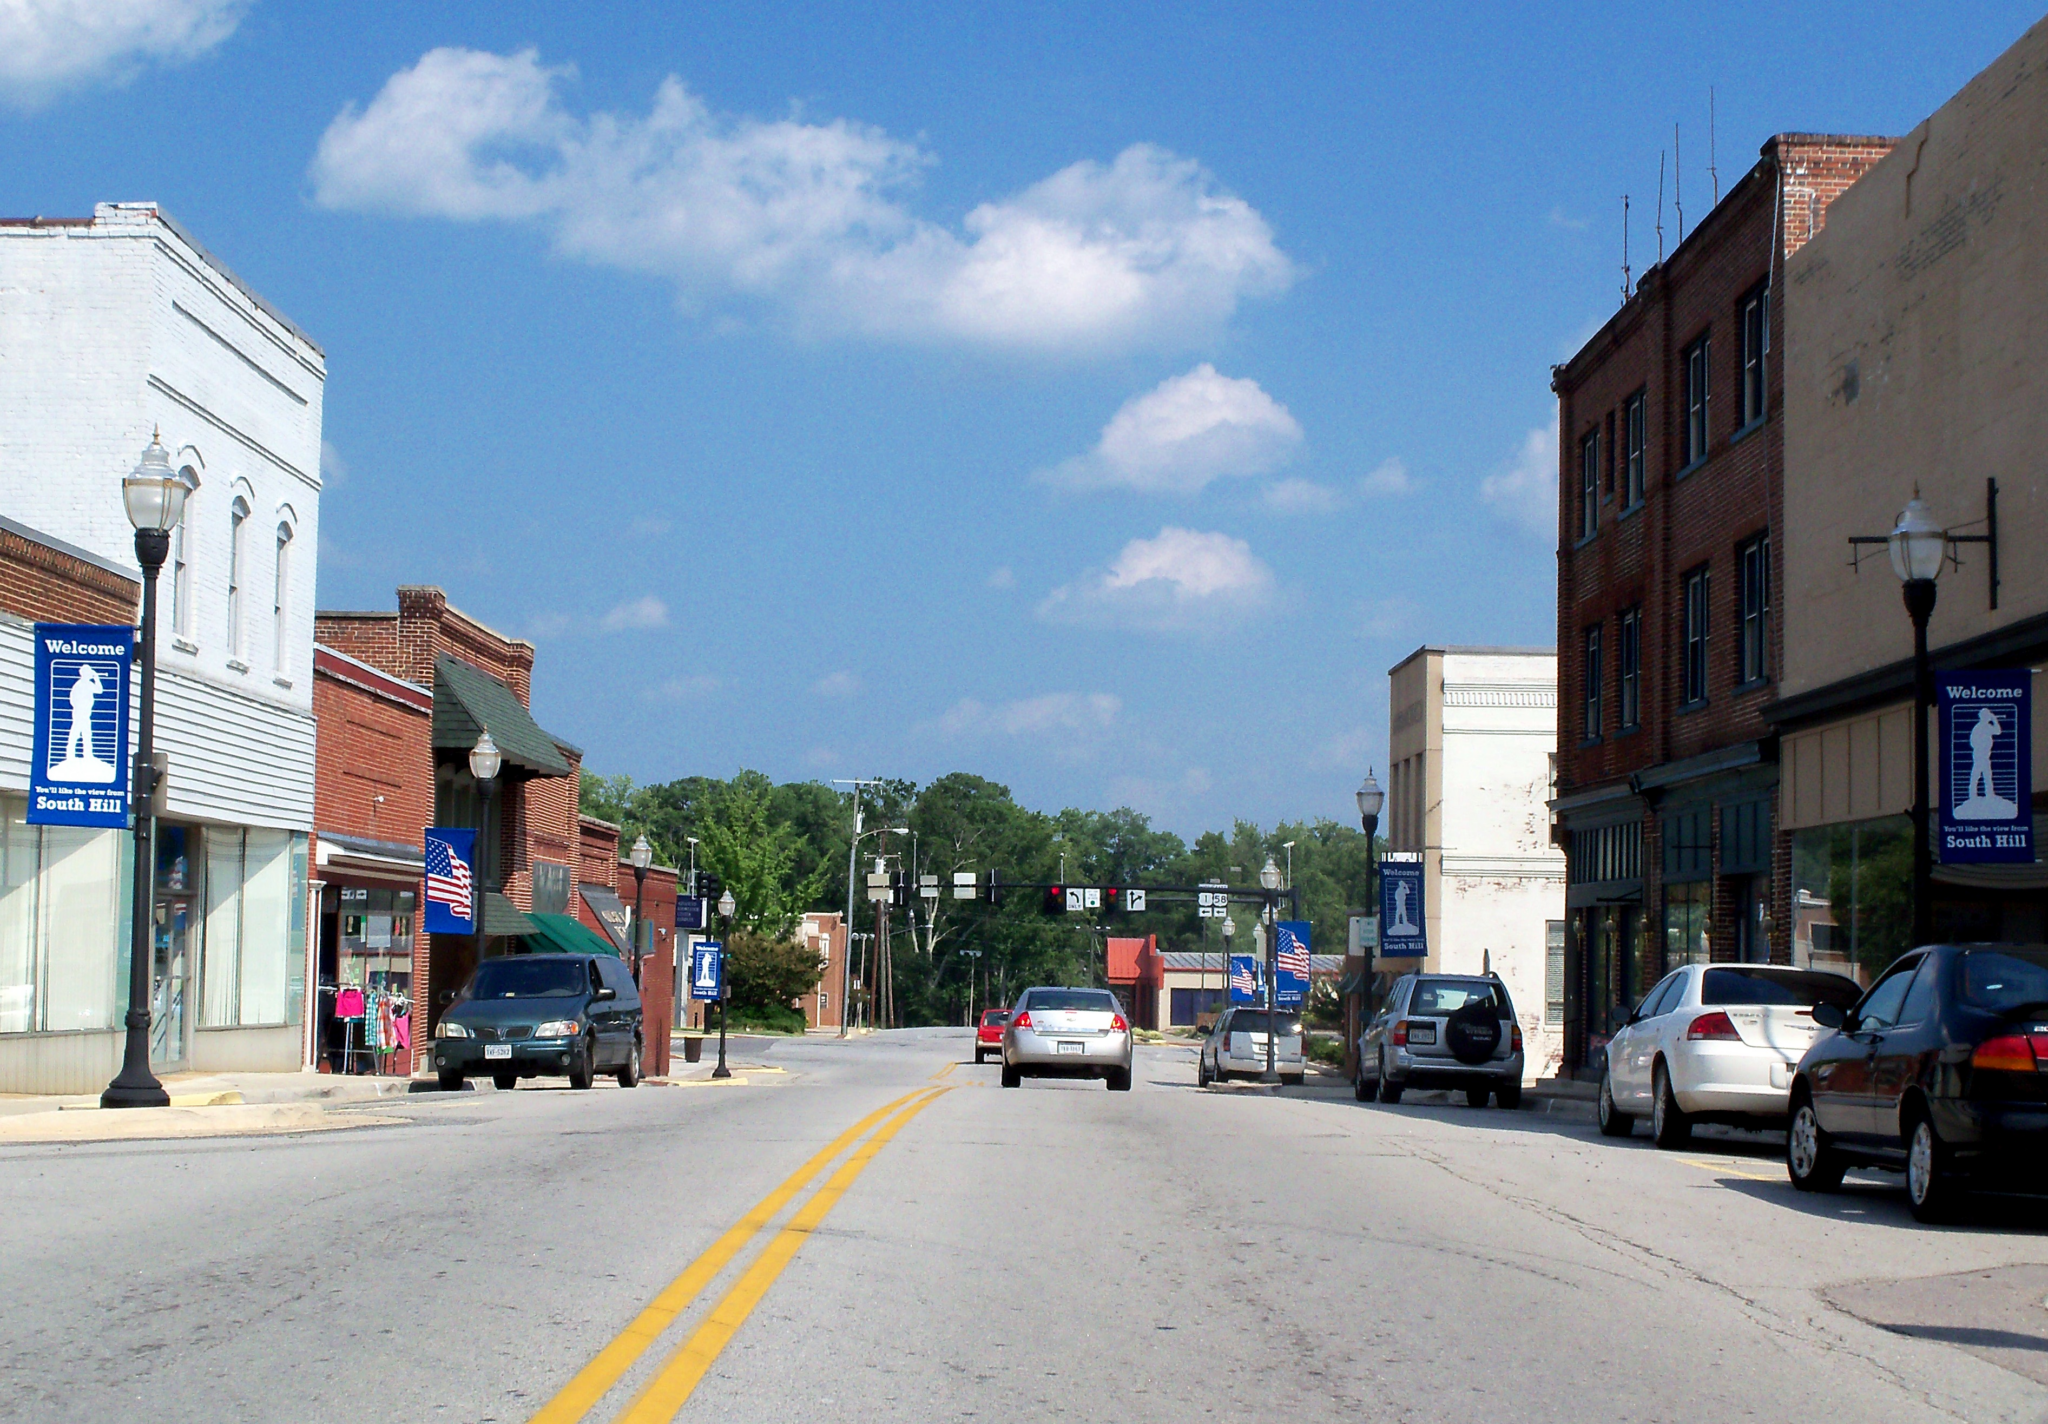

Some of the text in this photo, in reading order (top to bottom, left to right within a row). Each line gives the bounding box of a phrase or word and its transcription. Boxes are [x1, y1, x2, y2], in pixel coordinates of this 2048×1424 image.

[44, 639, 125, 656] Welcome
[1946, 686, 2023, 699] Welcome
[34, 786, 57, 794] You'll
[58, 787, 73, 795] like
[88, 788, 106, 796] view
[107, 789, 125, 797] from
[36, 796, 122, 813] South Hill
[1947, 834, 2027, 848] South Hill
[1382, 868, 1420, 876] Welcome
[1214, 895, 1227, 904] 58
[1384, 942, 1424, 950] South Hill
